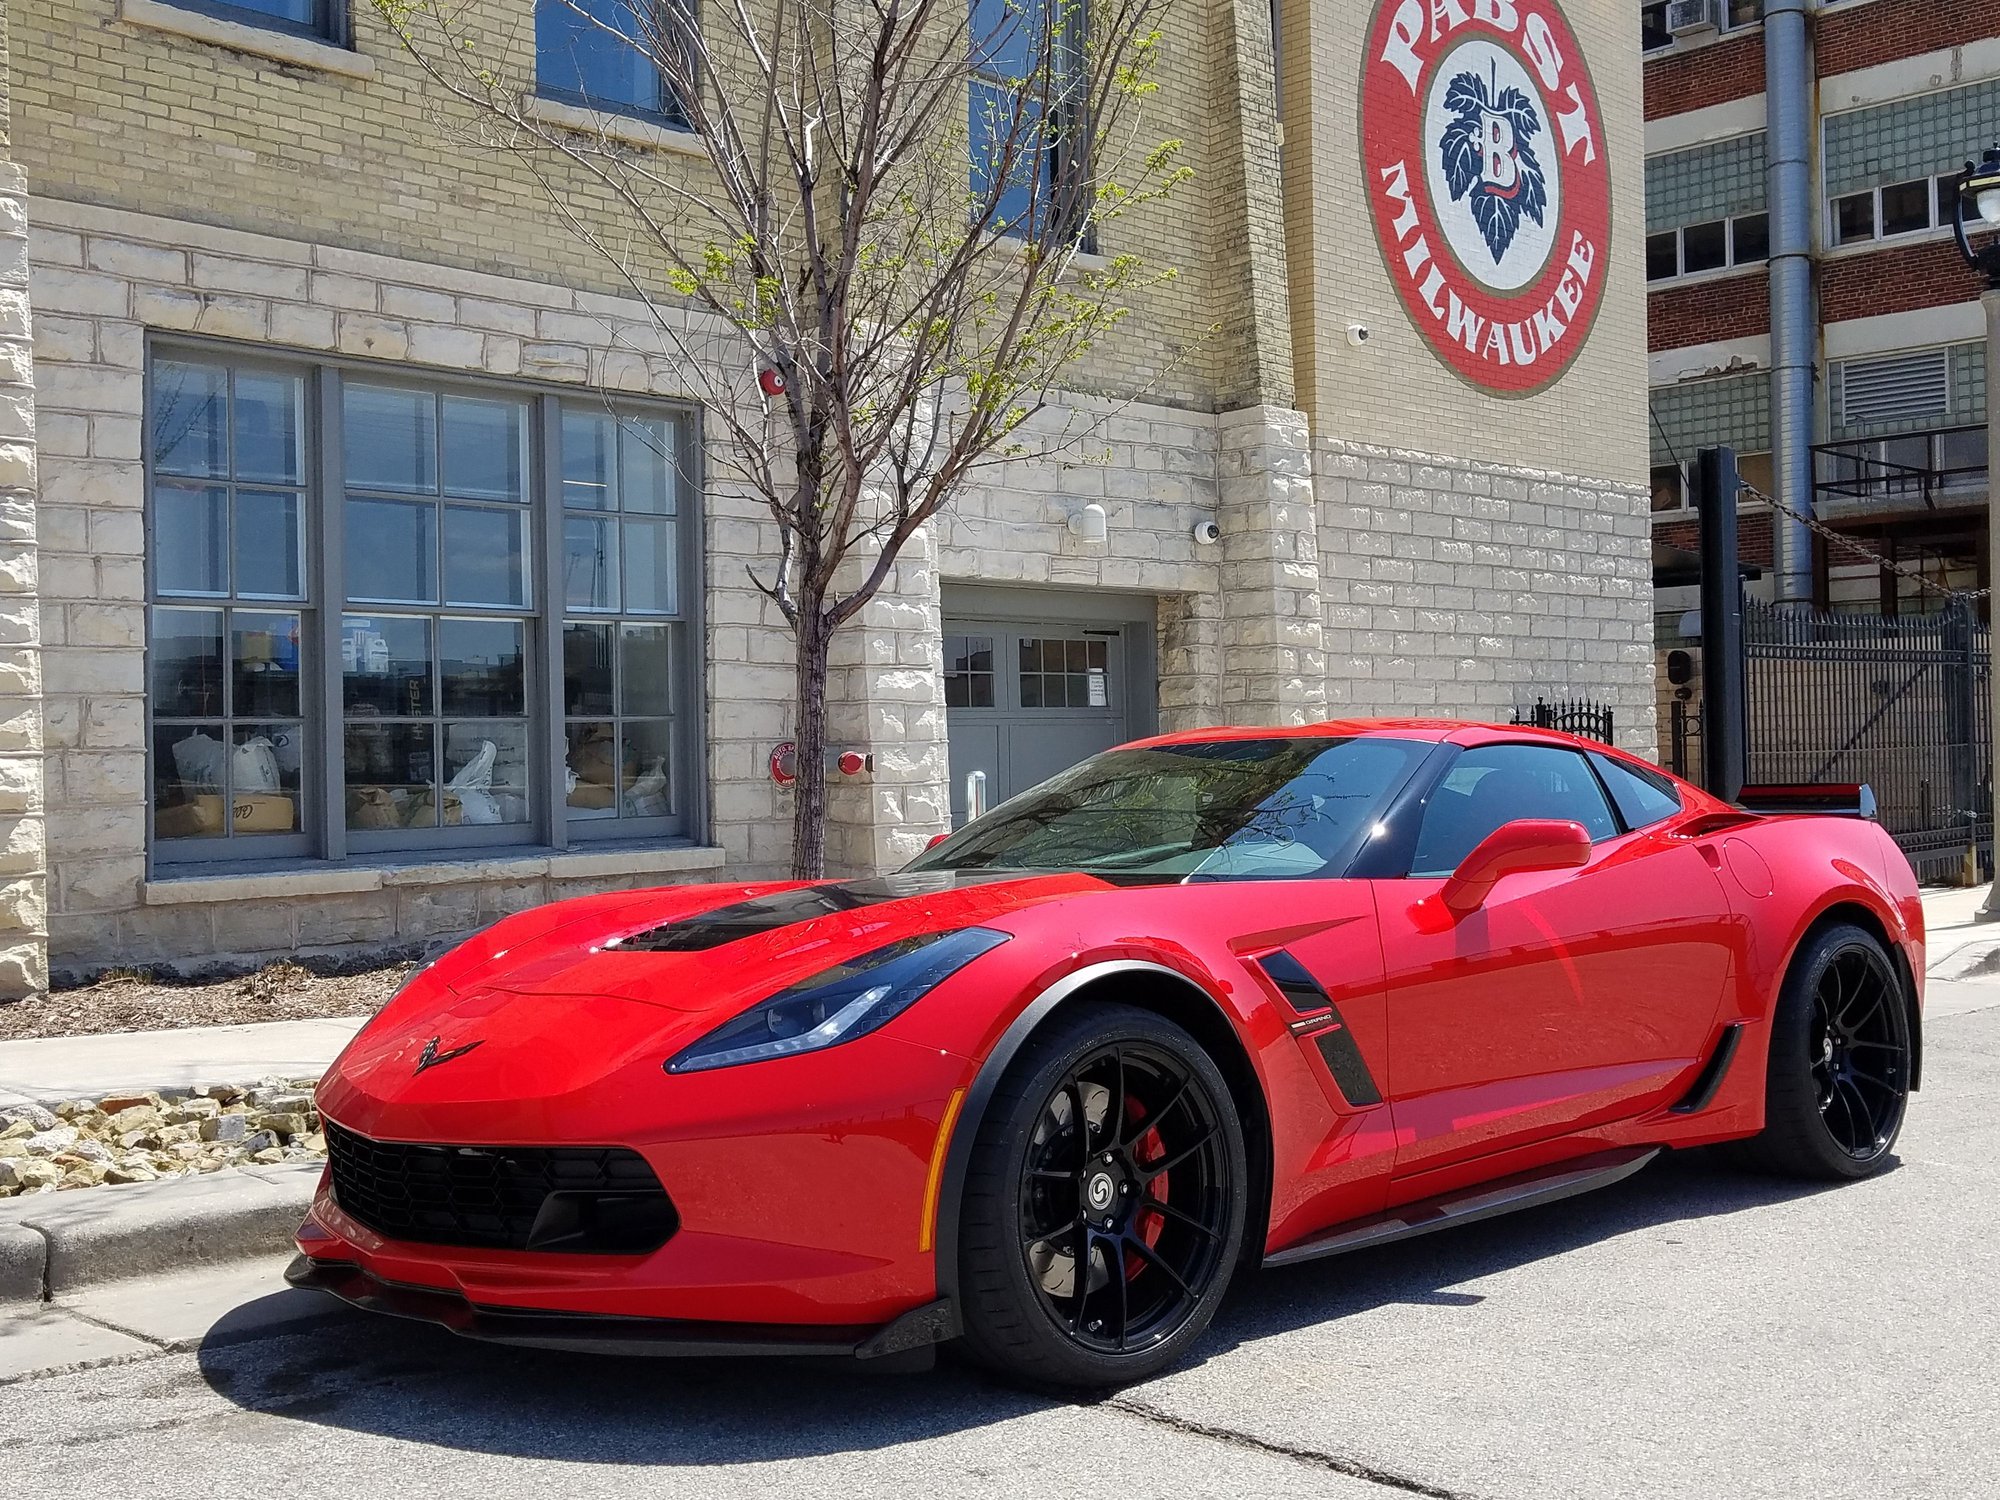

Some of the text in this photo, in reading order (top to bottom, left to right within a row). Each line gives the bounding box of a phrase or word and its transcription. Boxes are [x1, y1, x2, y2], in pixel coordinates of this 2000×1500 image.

[1380, 0, 1597, 167] PABST
[1480, 112, 1518, 188] B
[1381, 159, 1595, 366] MILWAUKEE
[1305, 1014, 1331, 1024] GRAND
